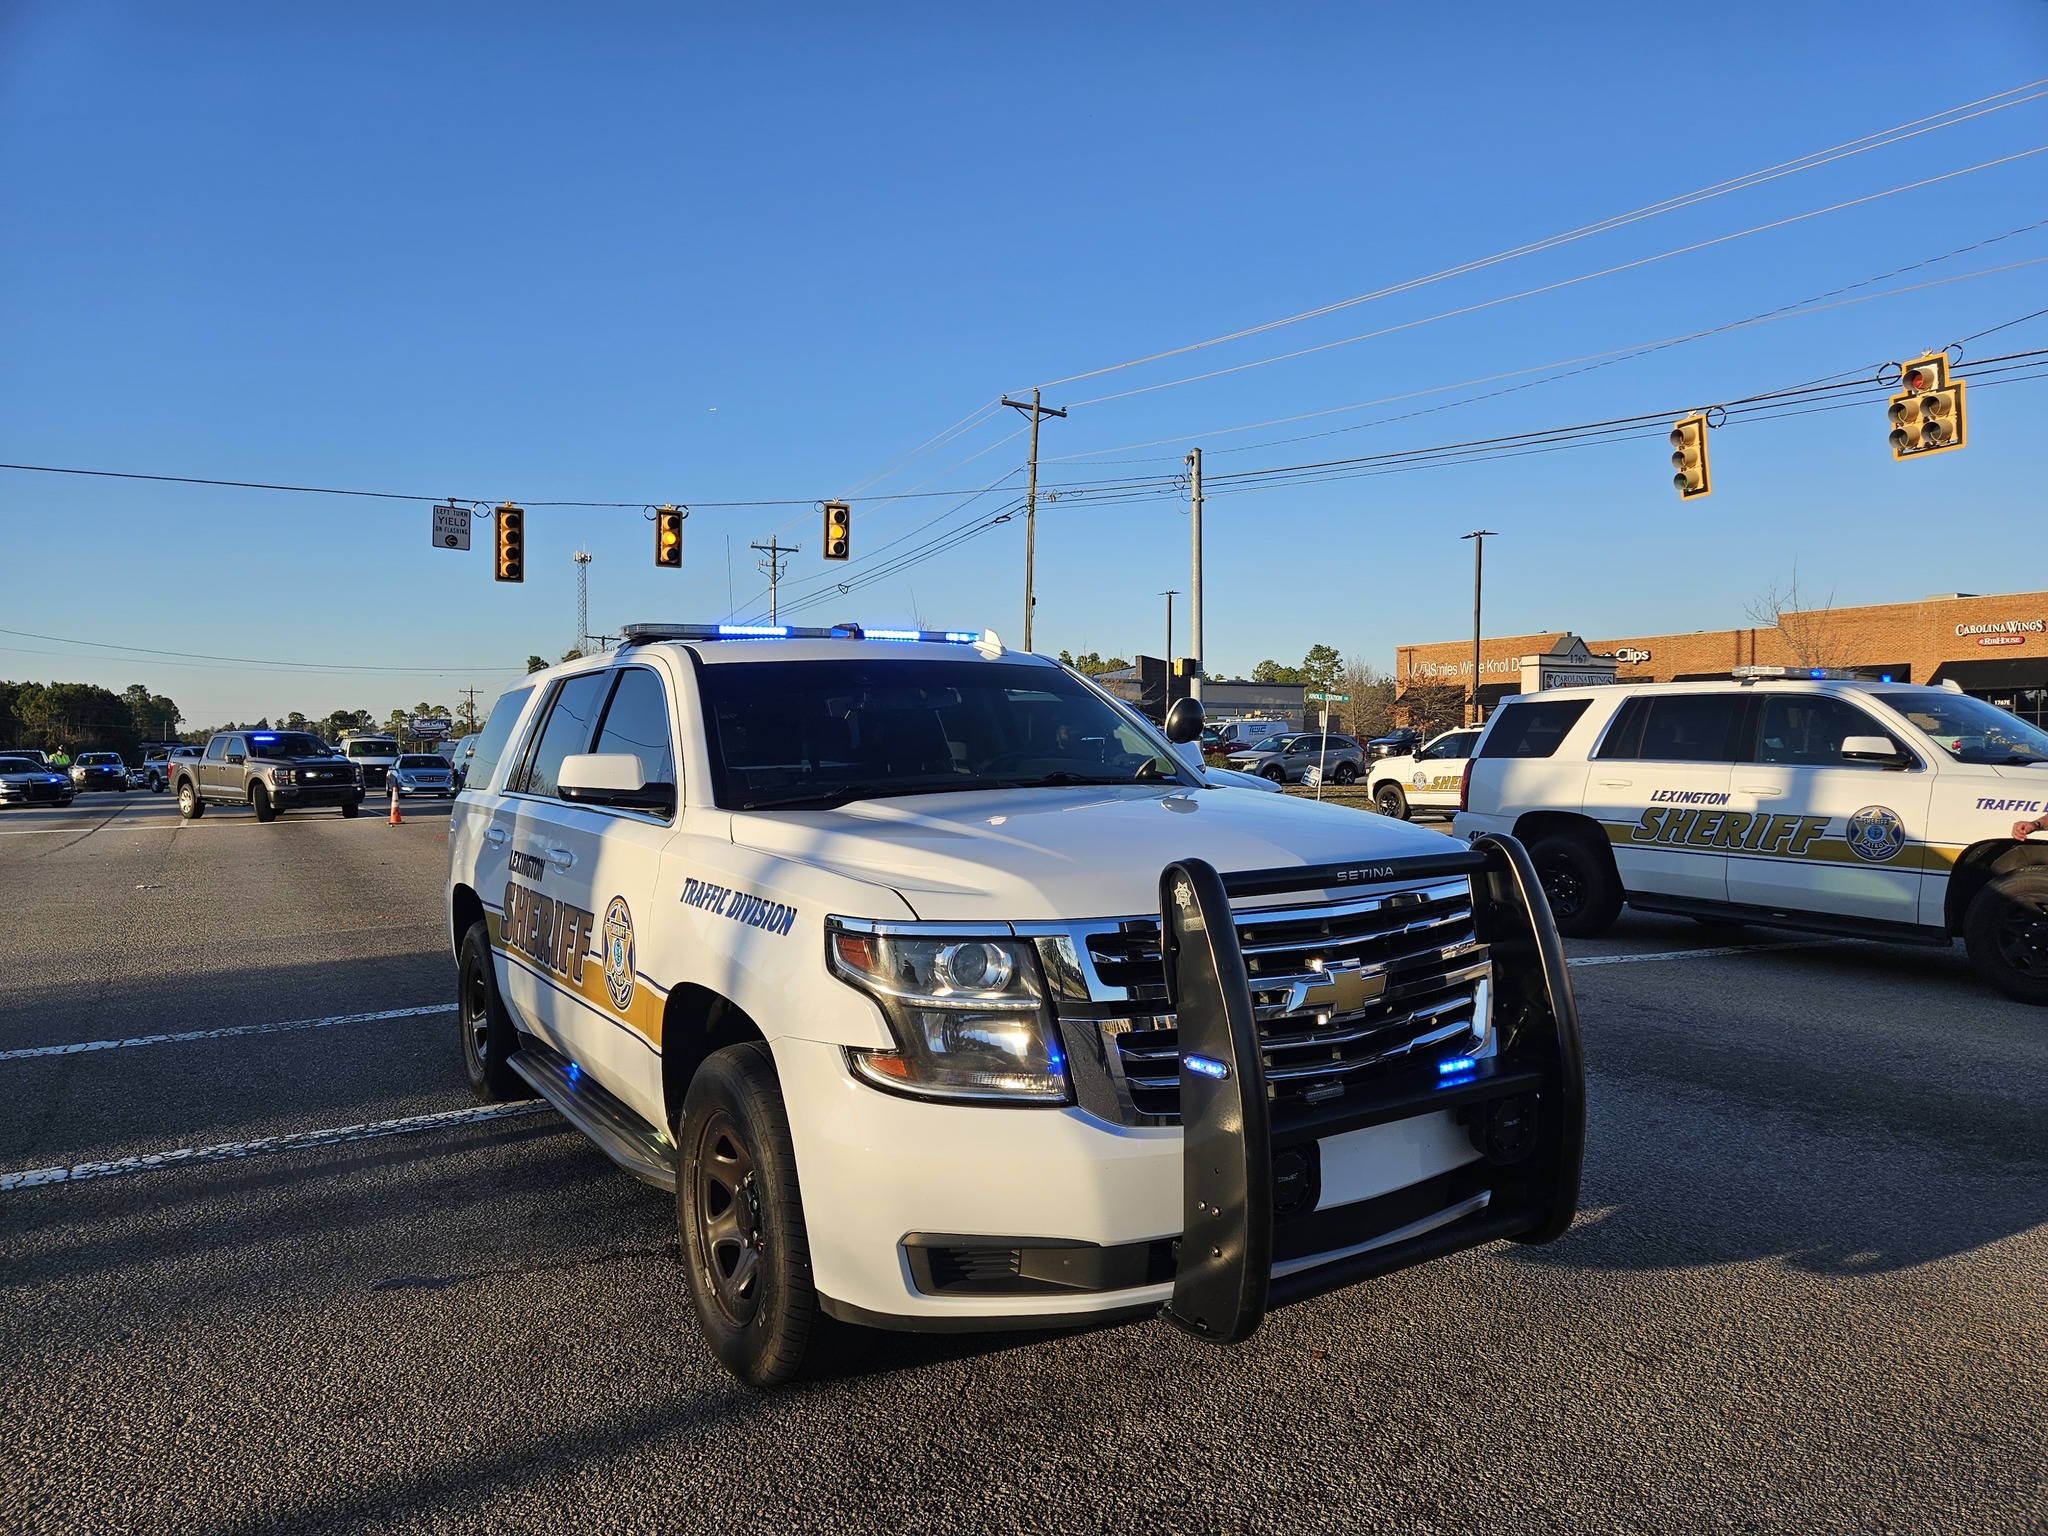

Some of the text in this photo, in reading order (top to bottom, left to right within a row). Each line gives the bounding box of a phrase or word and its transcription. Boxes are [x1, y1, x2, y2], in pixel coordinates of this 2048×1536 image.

[437, 515, 467, 527] YIELD
[453, 510, 468, 518] TURN
[444, 526, 468, 535] FLASHING
[1955, 619, 2044, 637] CAROLINA WINGS
[1570, 654, 1587, 664] 1767
[1615, 647, 1651, 665] Clips
[1430, 661, 1458, 677] Smiles
[1459, 659, 1485, 675] Whe
[1486, 657, 1509, 674] Knoll
[1553, 674, 1613, 688] CAROLINA WINGS
[1650, 790, 1731, 805] LEXINGTON
[1976, 798, 2041, 812] TRAFFIC
[1862, 818, 1889, 826] SHERIFF
[1631, 807, 1832, 854] SHERIFF
[508, 849, 546, 882] LEXINGTON
[1337, 866, 1394, 882] SETINA
[680, 877, 797, 936] TRAFFIC DIVISION
[500, 881, 595, 987] SHERIFF
